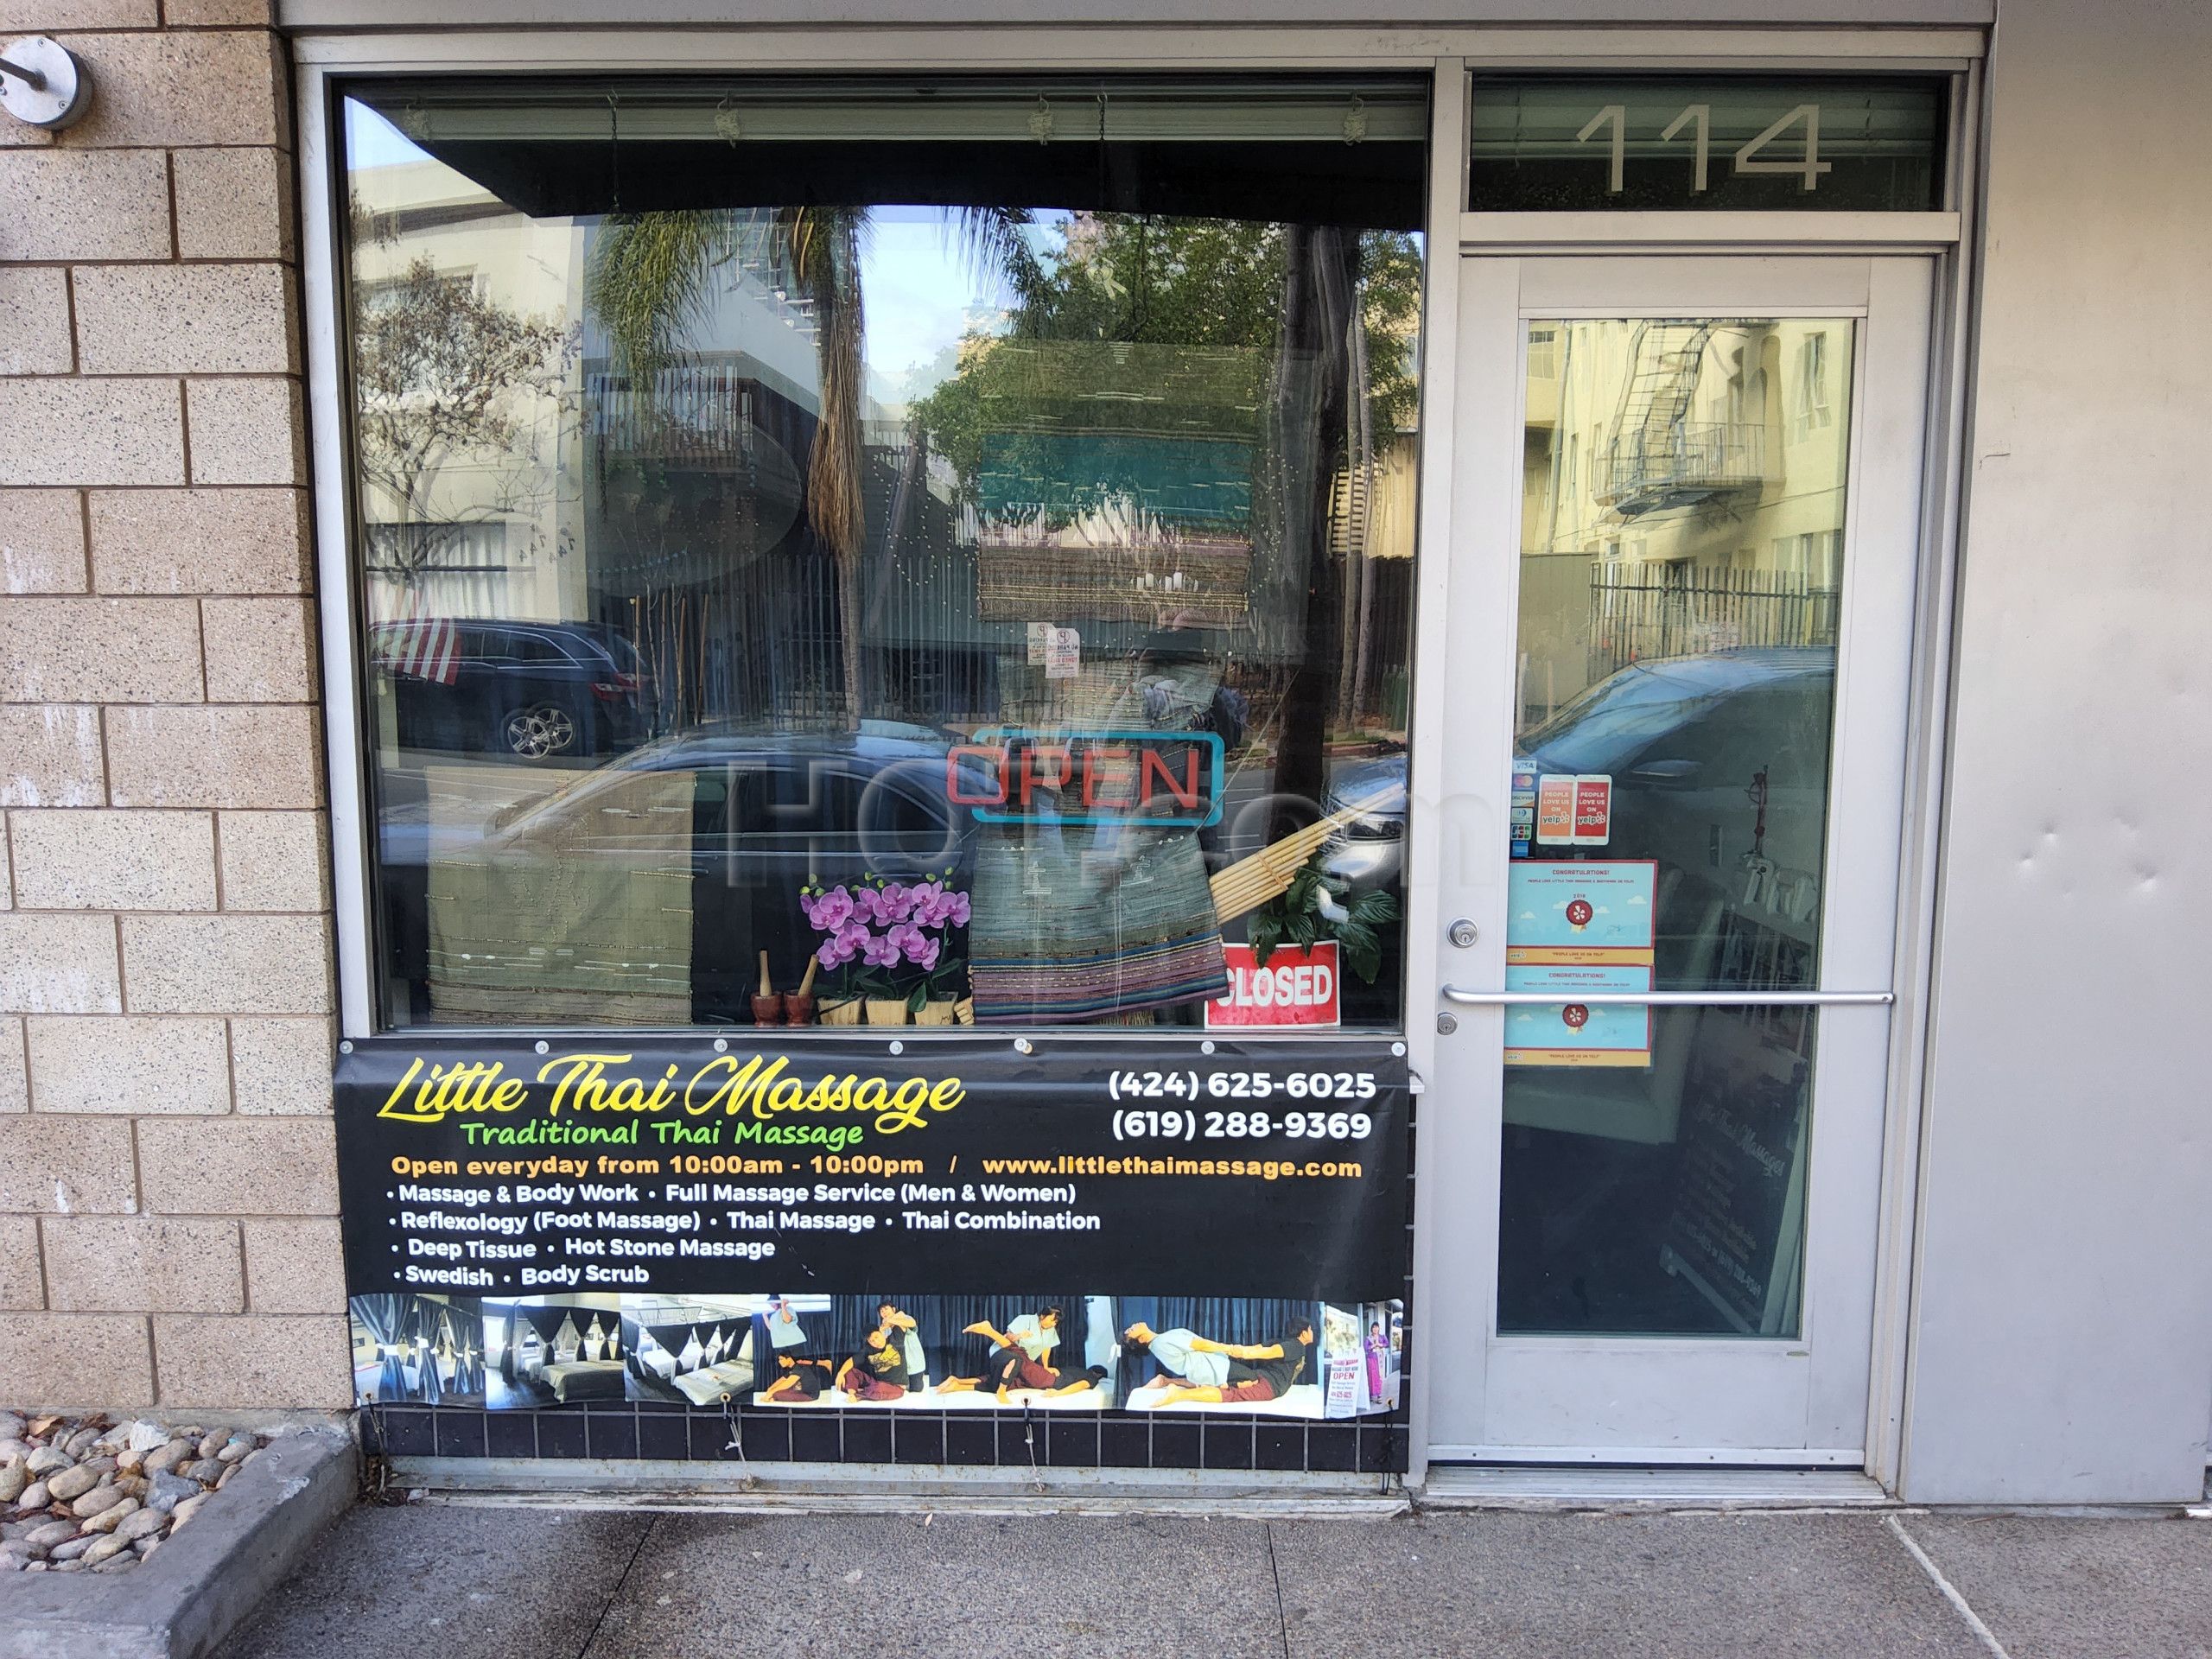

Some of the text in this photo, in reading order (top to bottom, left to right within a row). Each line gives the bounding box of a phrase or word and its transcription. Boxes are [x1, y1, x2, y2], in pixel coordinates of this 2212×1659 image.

[1576, 105, 1832, 192] 114
[947, 747, 1199, 808] OPEN
[1542, 816, 1560, 825] yelp
[1579, 816, 1597, 825] yelp
[378, 1054, 966, 1134] Little Thai Massage
[1109, 1071, 1376, 1102] (424) 625-6025
[460, 1119, 865, 1152] Traditional Thai Massage
[1112, 1109, 1372, 1141] (619) 288-9369
[391, 1156, 458, 1179] Open
[467, 1155, 589, 1179] everyday
[597, 1155, 659, 1174] from
[670, 1155, 783, 1174] 10:00am
[810, 1155, 924, 1178] 10:00pm
[982, 1155, 1362, 1180] www.littlethaimassage.com
[398, 1182, 1076, 1207] Massage & Body Work Full Massage Service (Men & Women)
[401, 1210, 1101, 1236] Reflexology (Foot Massage) Thai Massage Thai Combination
[408, 1237, 776, 1262] Deep Tissue Hot Stone Massage
[405, 1264, 650, 1287] Swedish Body Scrub
